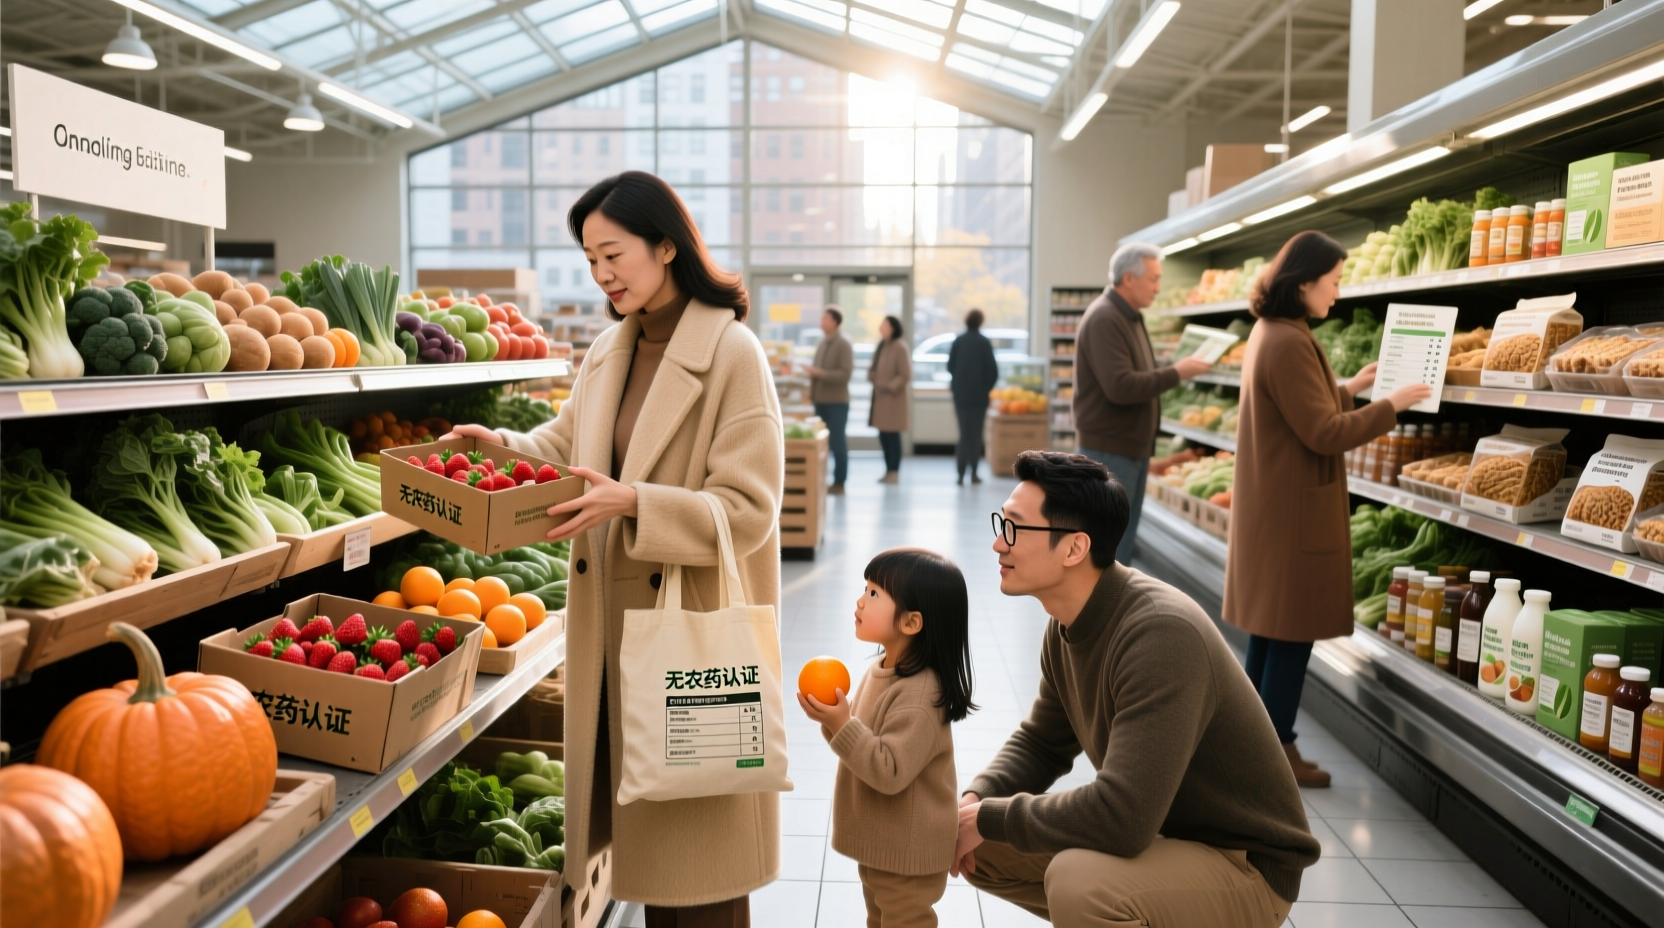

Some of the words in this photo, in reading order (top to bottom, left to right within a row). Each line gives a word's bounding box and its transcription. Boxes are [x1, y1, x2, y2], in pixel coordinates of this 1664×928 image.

[665, 665, 761, 690] 无农药认证
[251, 689, 352, 735] 农药认证
